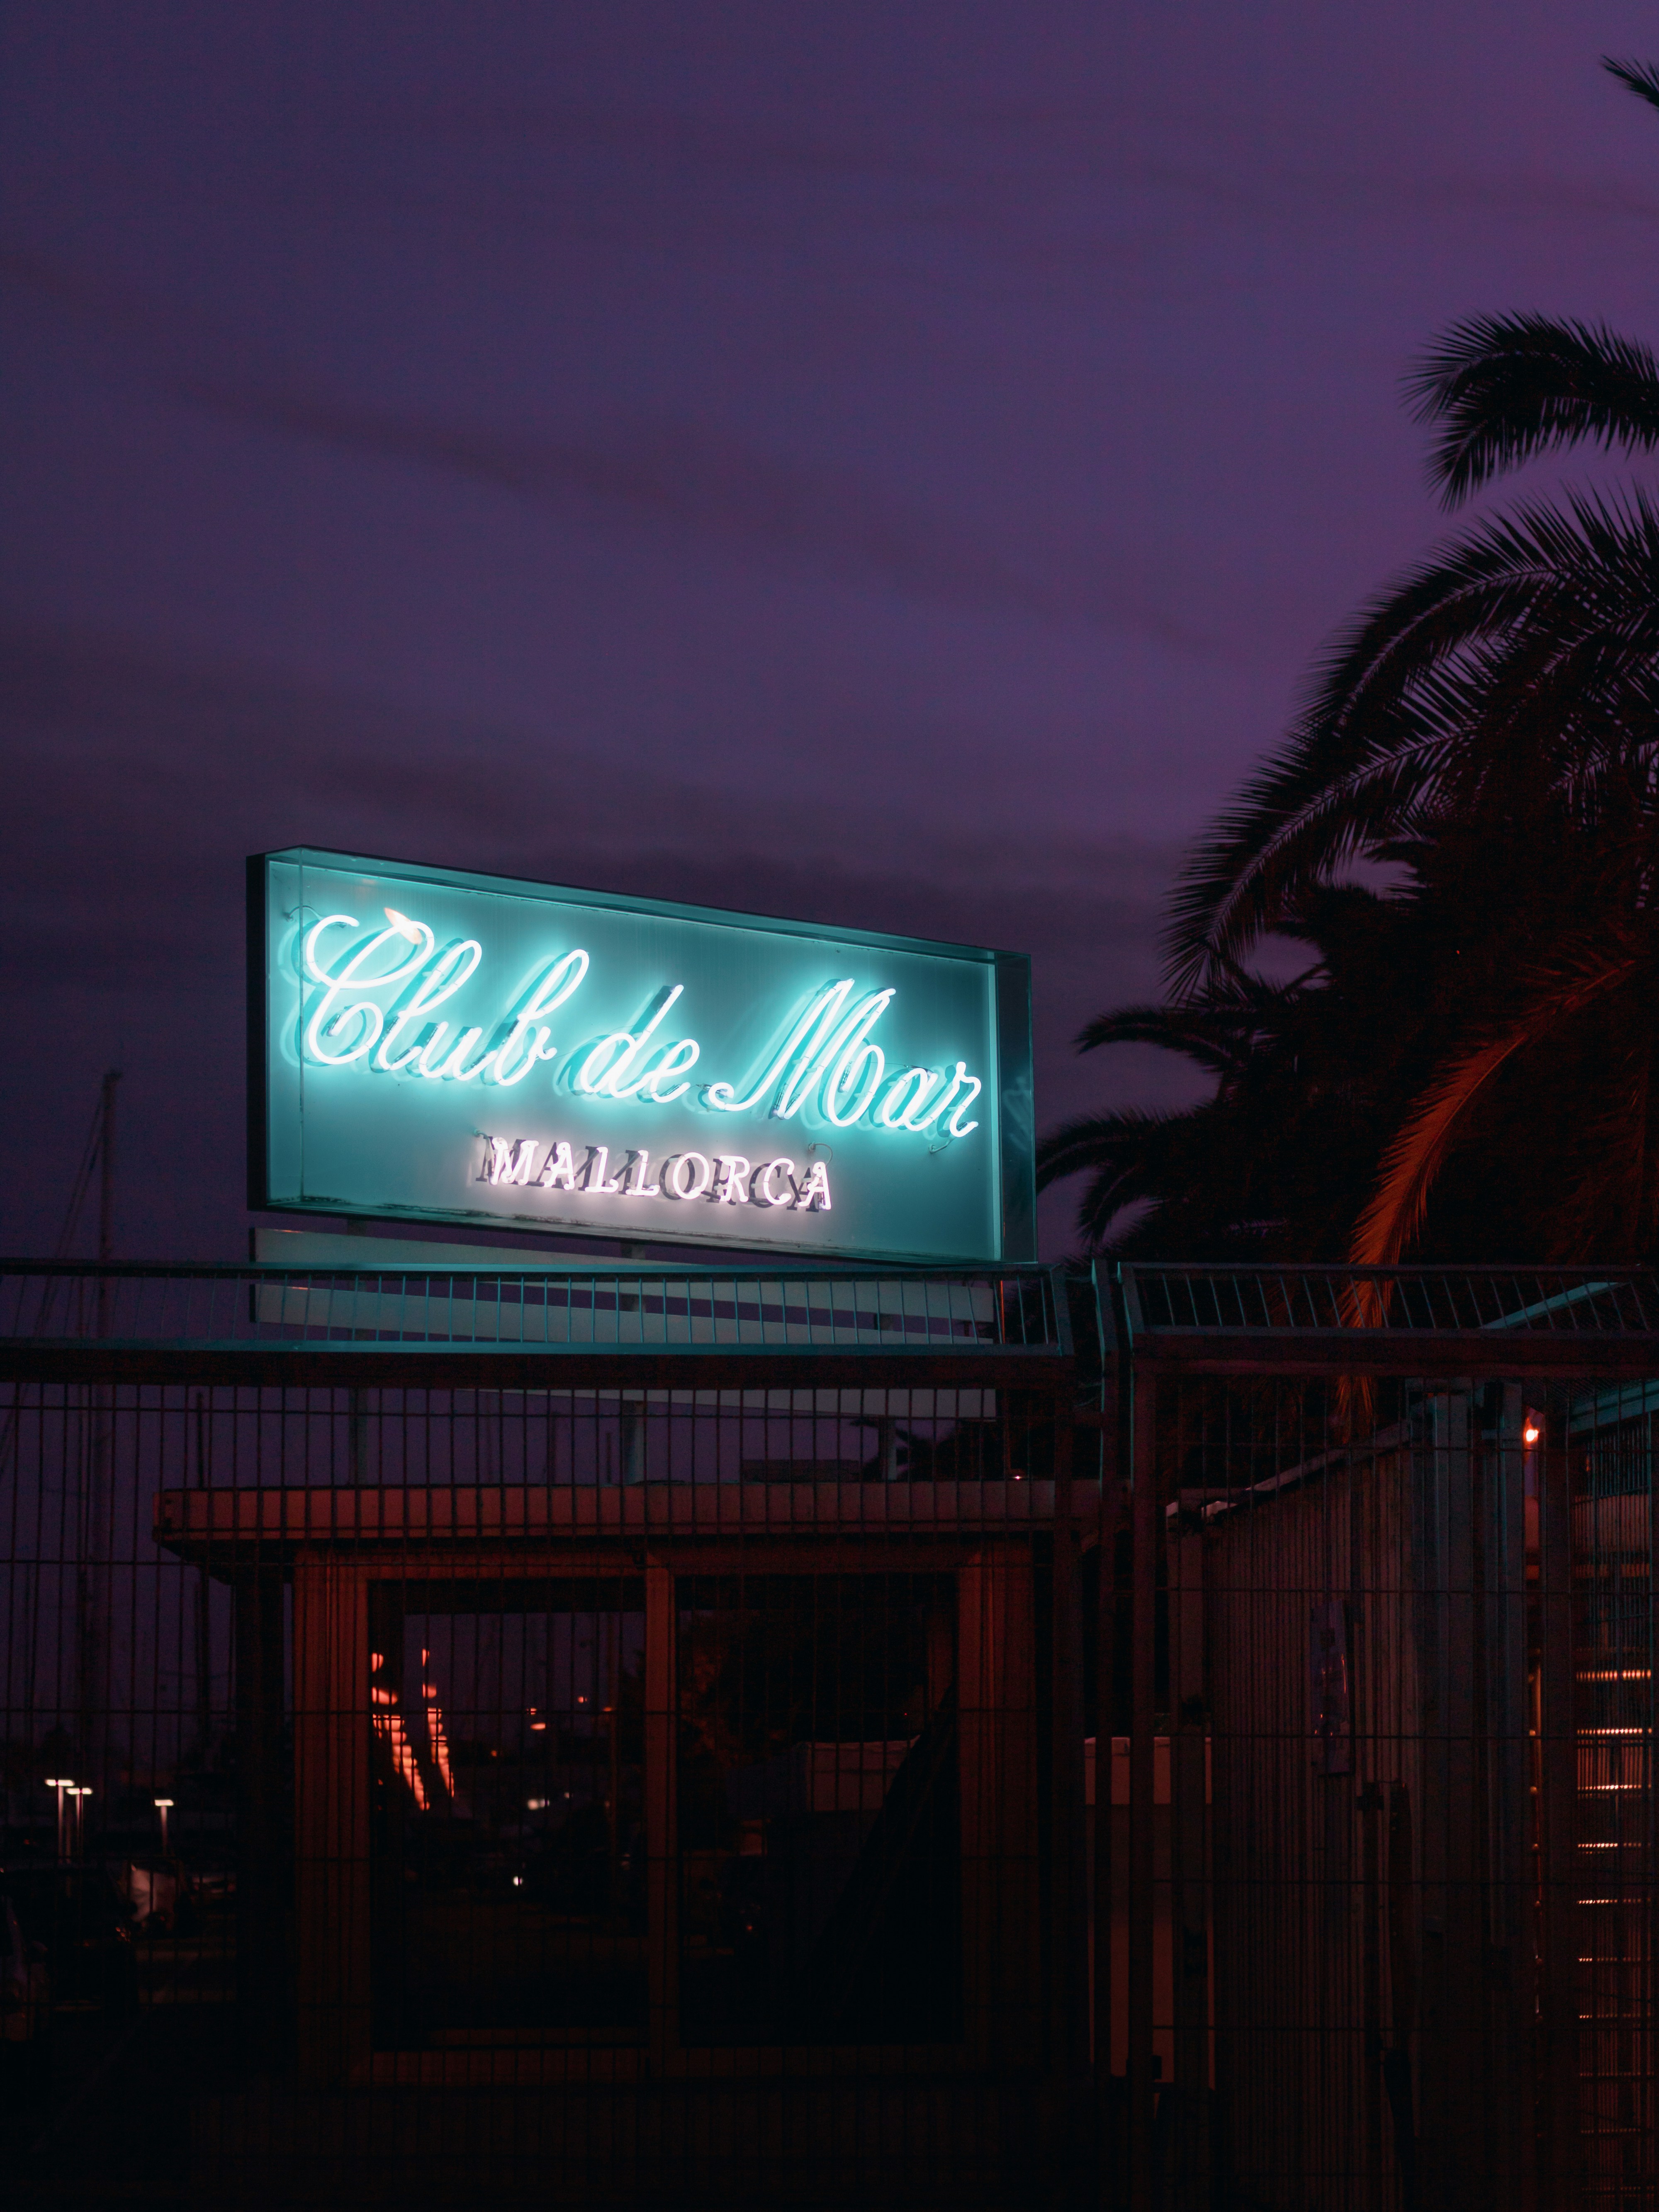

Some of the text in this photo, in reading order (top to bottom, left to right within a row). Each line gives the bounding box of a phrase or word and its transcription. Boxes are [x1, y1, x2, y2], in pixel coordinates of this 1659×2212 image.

[306, 914, 982, 1137] Club de Mar
[483, 1136, 832, 1211] MALLORCA
